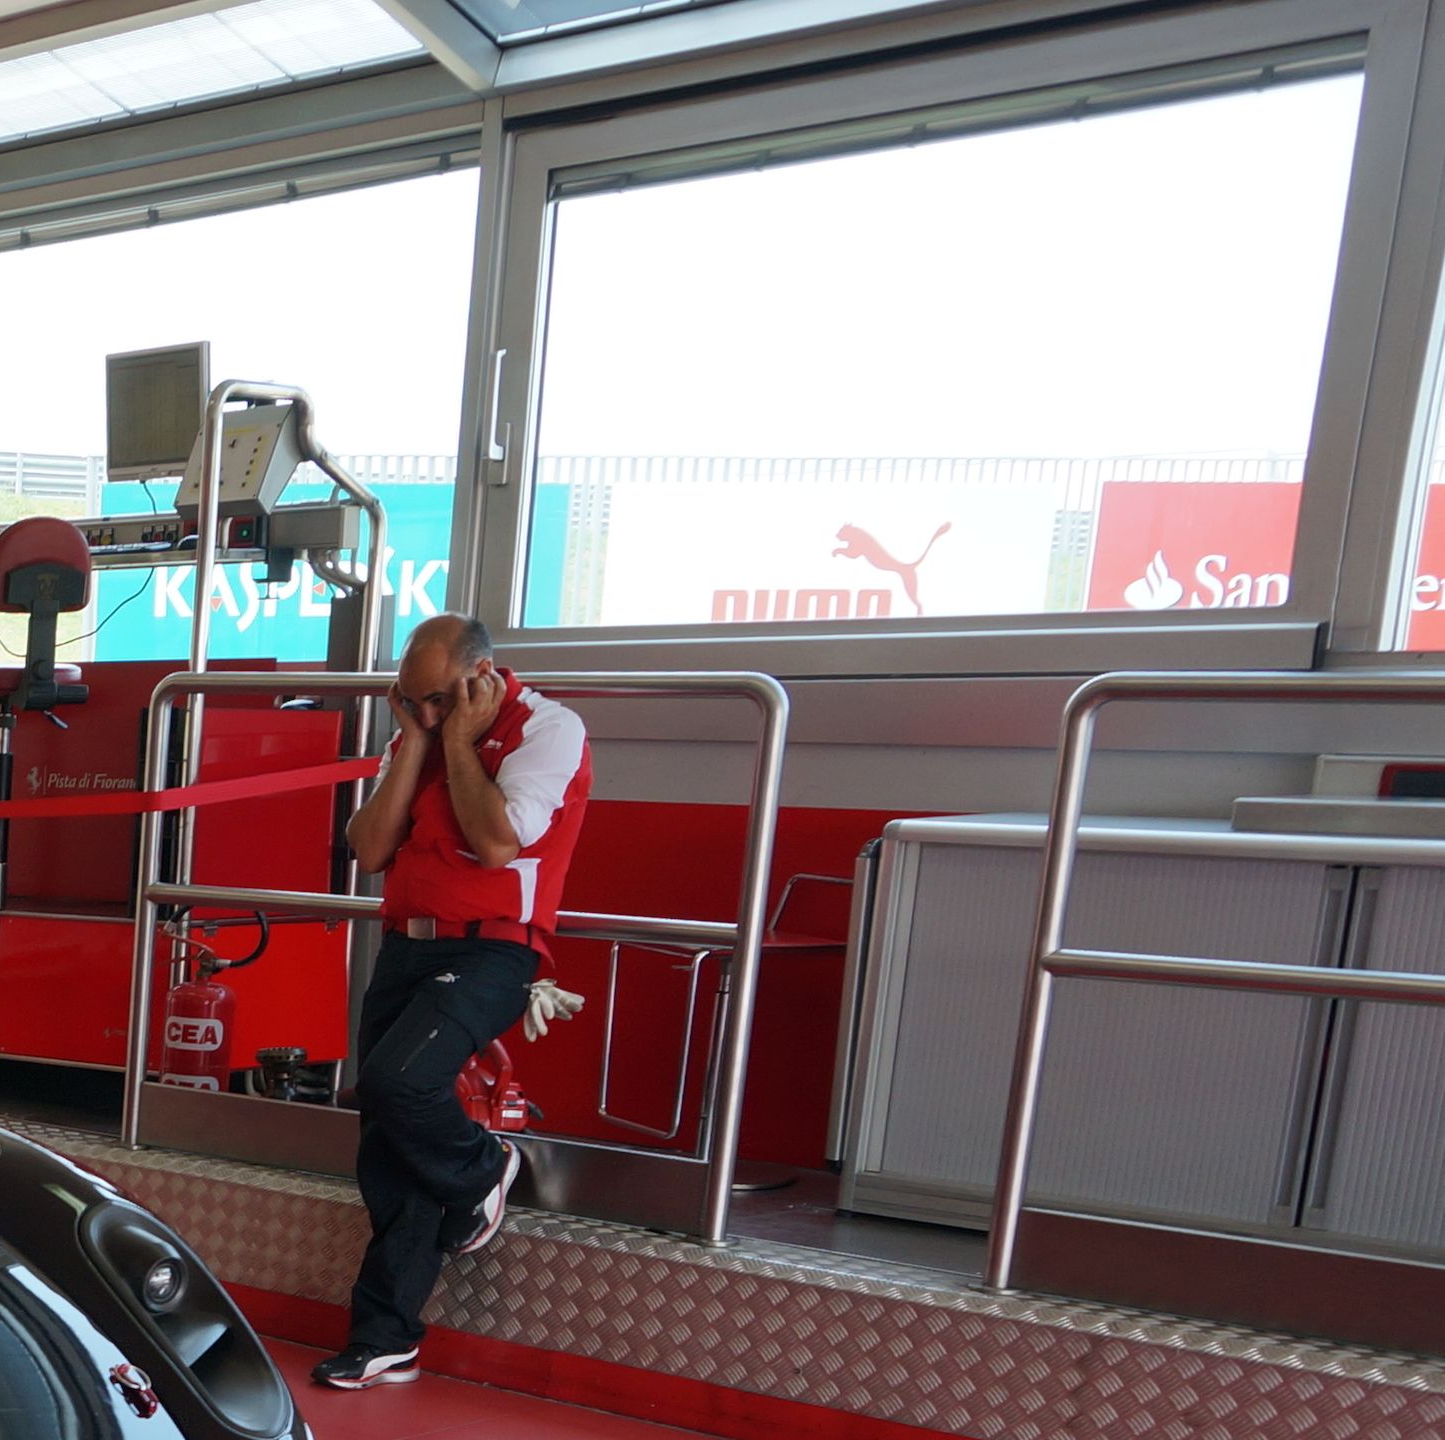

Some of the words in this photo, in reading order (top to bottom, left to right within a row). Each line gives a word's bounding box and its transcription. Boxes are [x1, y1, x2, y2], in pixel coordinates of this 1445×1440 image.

[48, 773, 76, 788] Pista
[78, 773, 90, 788] di
[93, 773, 136, 789] Fioran
[167, 1021, 218, 1045] CEA
